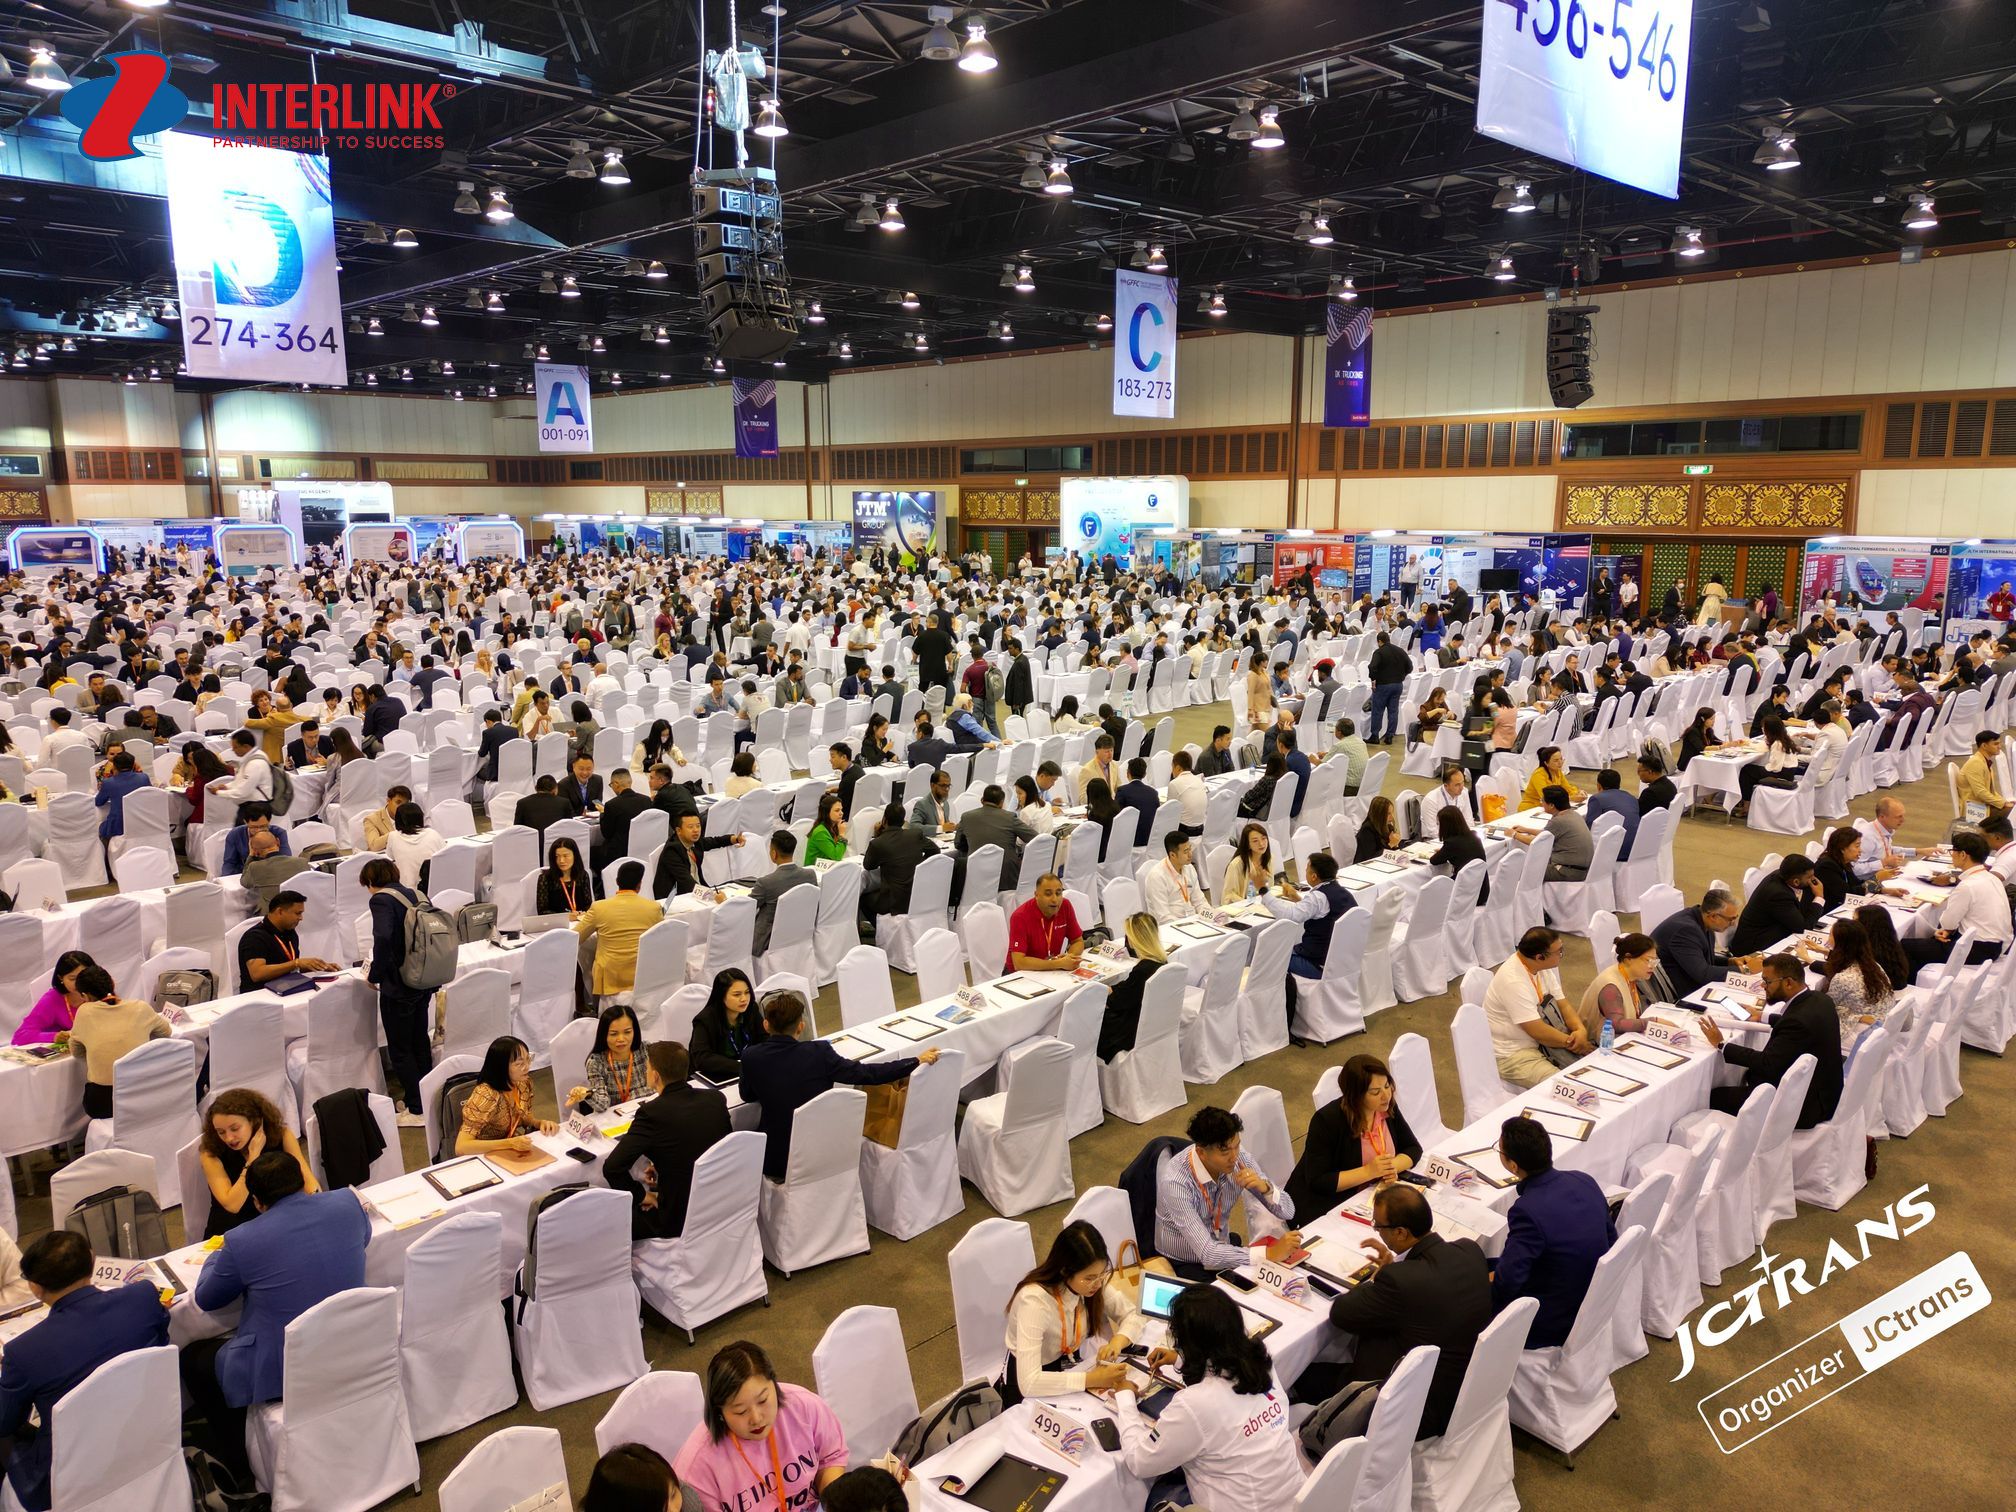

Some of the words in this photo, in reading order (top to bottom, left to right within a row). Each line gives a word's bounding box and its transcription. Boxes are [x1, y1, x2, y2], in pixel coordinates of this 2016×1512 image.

[211, 188, 304, 308] D
[188, 315, 339, 355] 274-364
[1129, 302, 1164, 373] C
[1117, 378, 1172, 400] 183-273
[544, 381, 585, 425] A
[541, 427, 590, 441] 001-091
[855, 500, 887, 517] JTM
[861, 518, 886, 530] GROUP
[1102, 945, 1115, 955] 487
[1728, 976, 1748, 988] 504
[957, 989, 971, 1002] 488
[1648, 1025, 1670, 1041] 503
[1553, 1083, 1576, 1100] 502
[569, 1119, 582, 1132] 490
[1428, 1160, 1452, 1181] 501
[96, 1266, 122, 1281] 492
[1257, 1268, 1282, 1288] 500
[1035, 1415, 1061, 1438] 499
[1243, 1401, 1282, 1438] abreco
